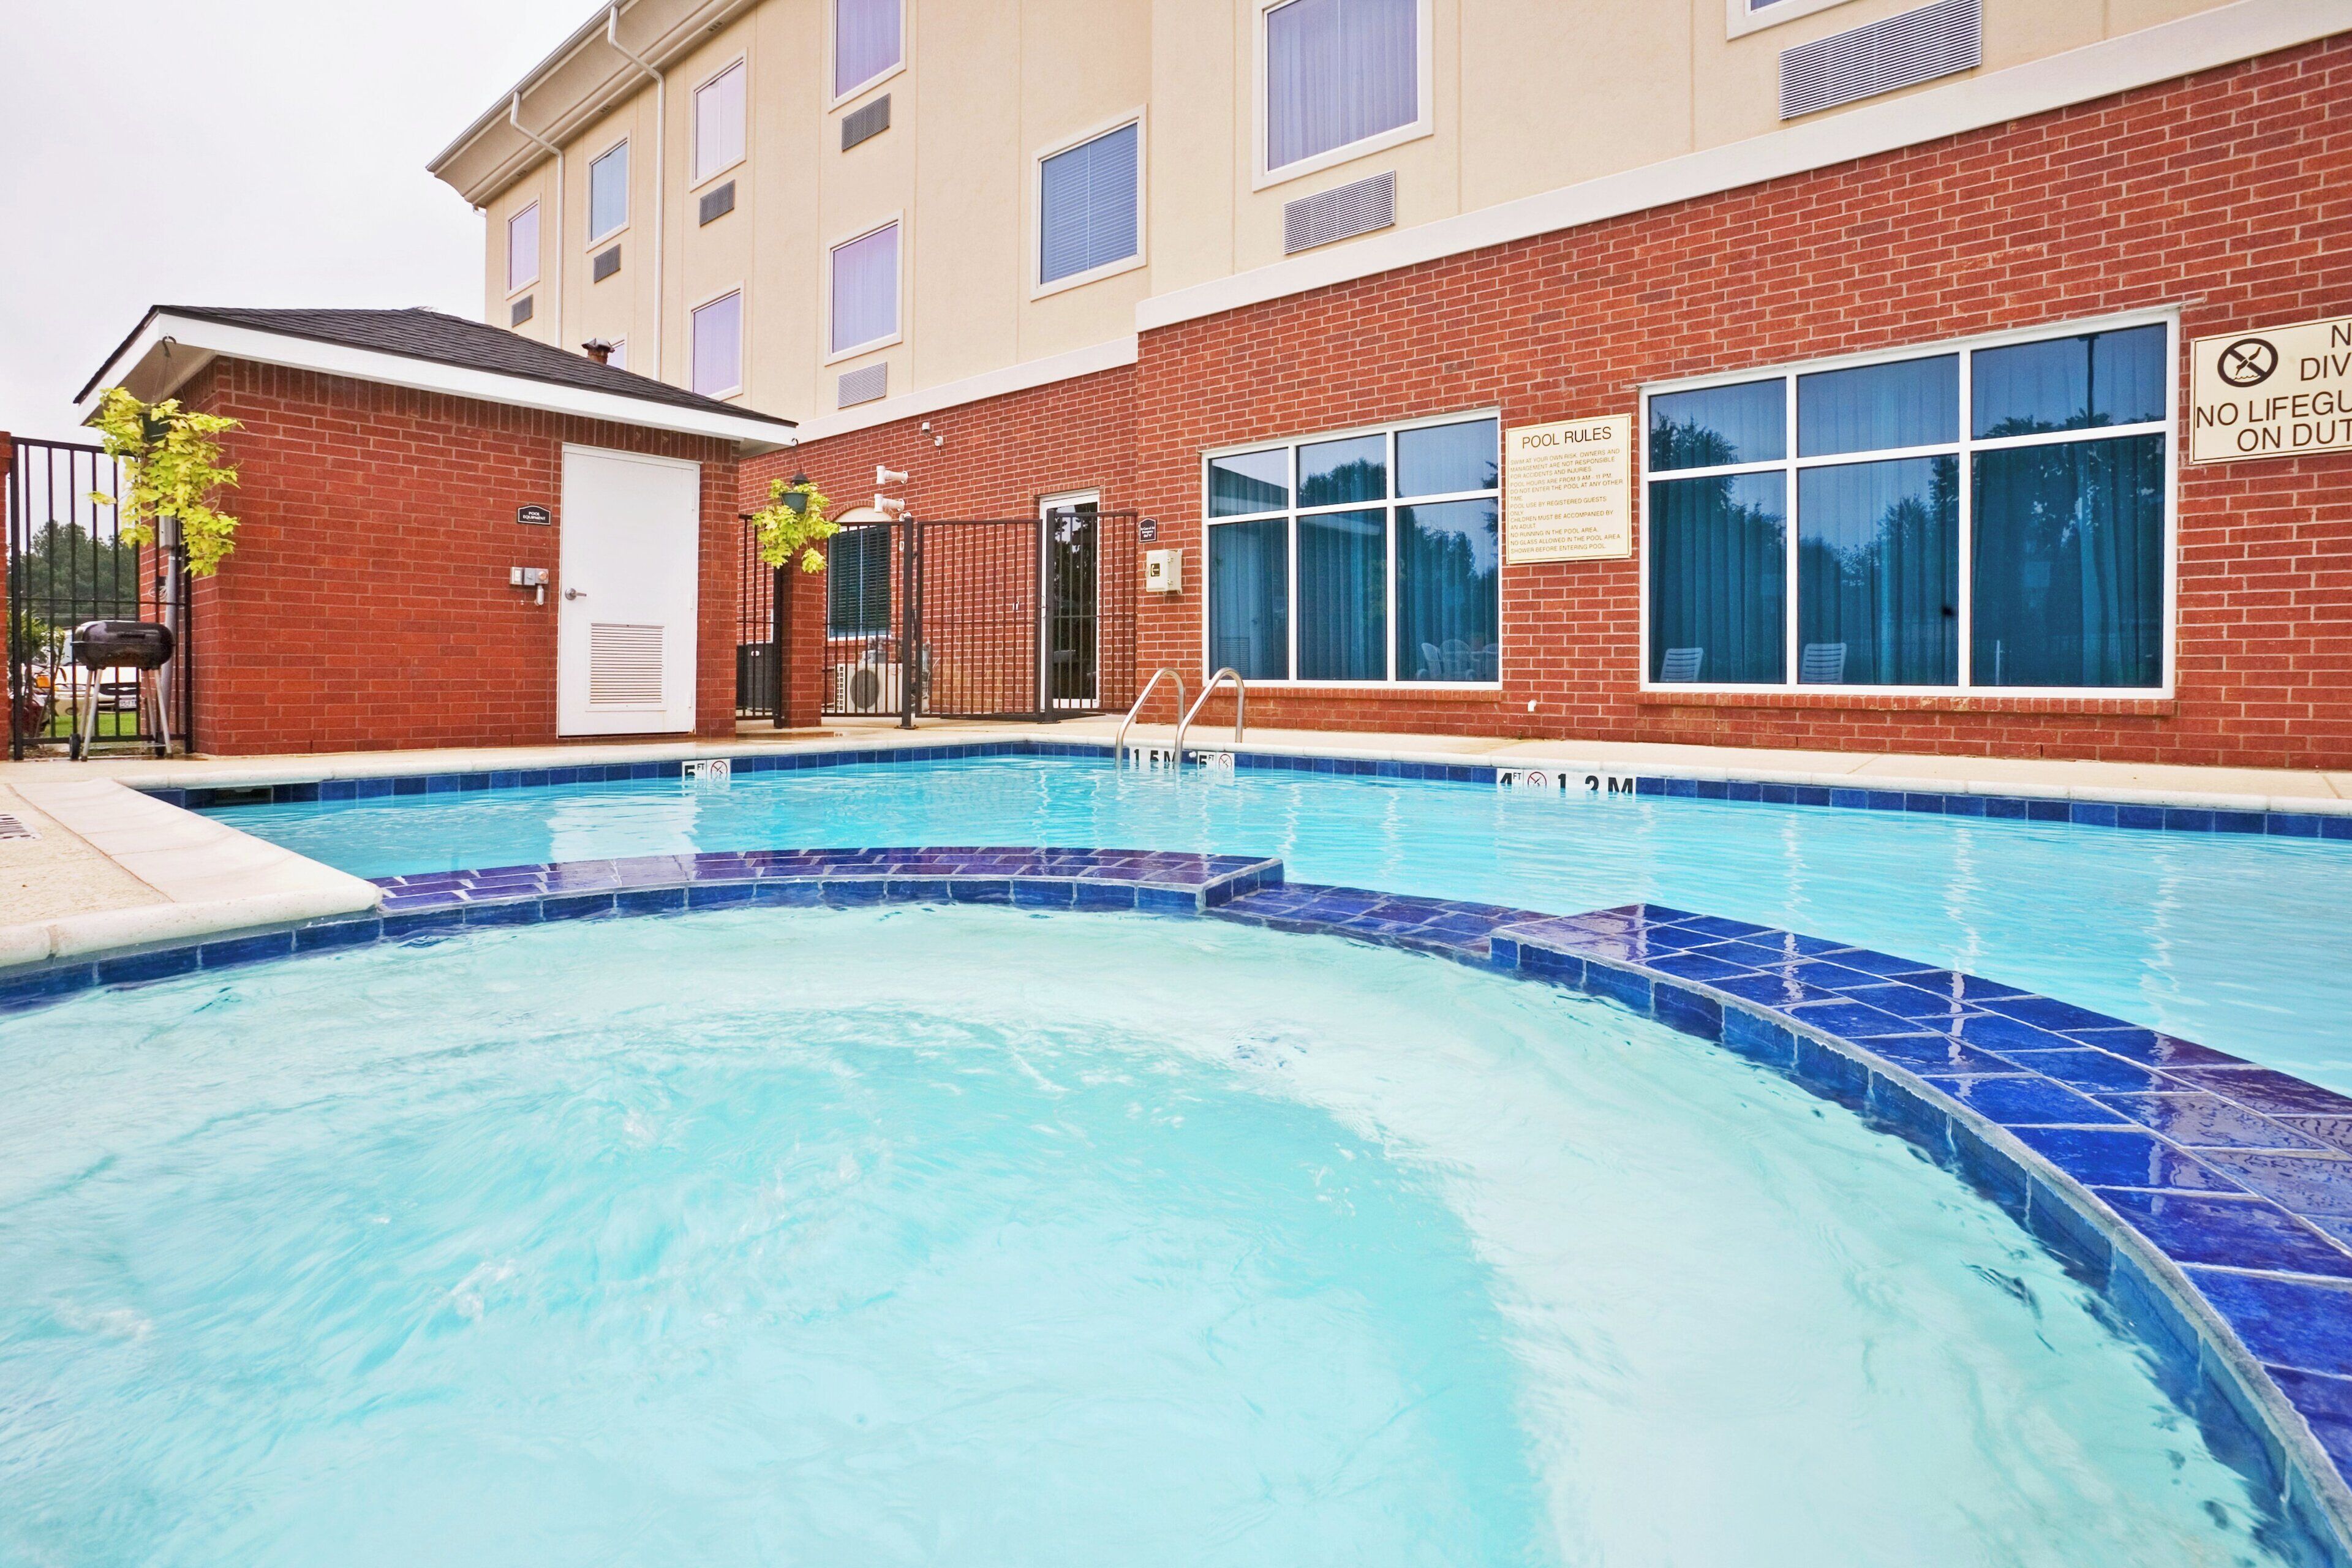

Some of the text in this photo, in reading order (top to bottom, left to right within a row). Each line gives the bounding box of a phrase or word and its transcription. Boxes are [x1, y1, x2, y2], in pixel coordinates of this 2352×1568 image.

[2196, 402, 2239, 429] NO
[1523, 426, 1611, 449] POOL RULES
[2237, 426, 2281, 452] ON
[1575, 456, 1615, 465] RESPONSIBLE
